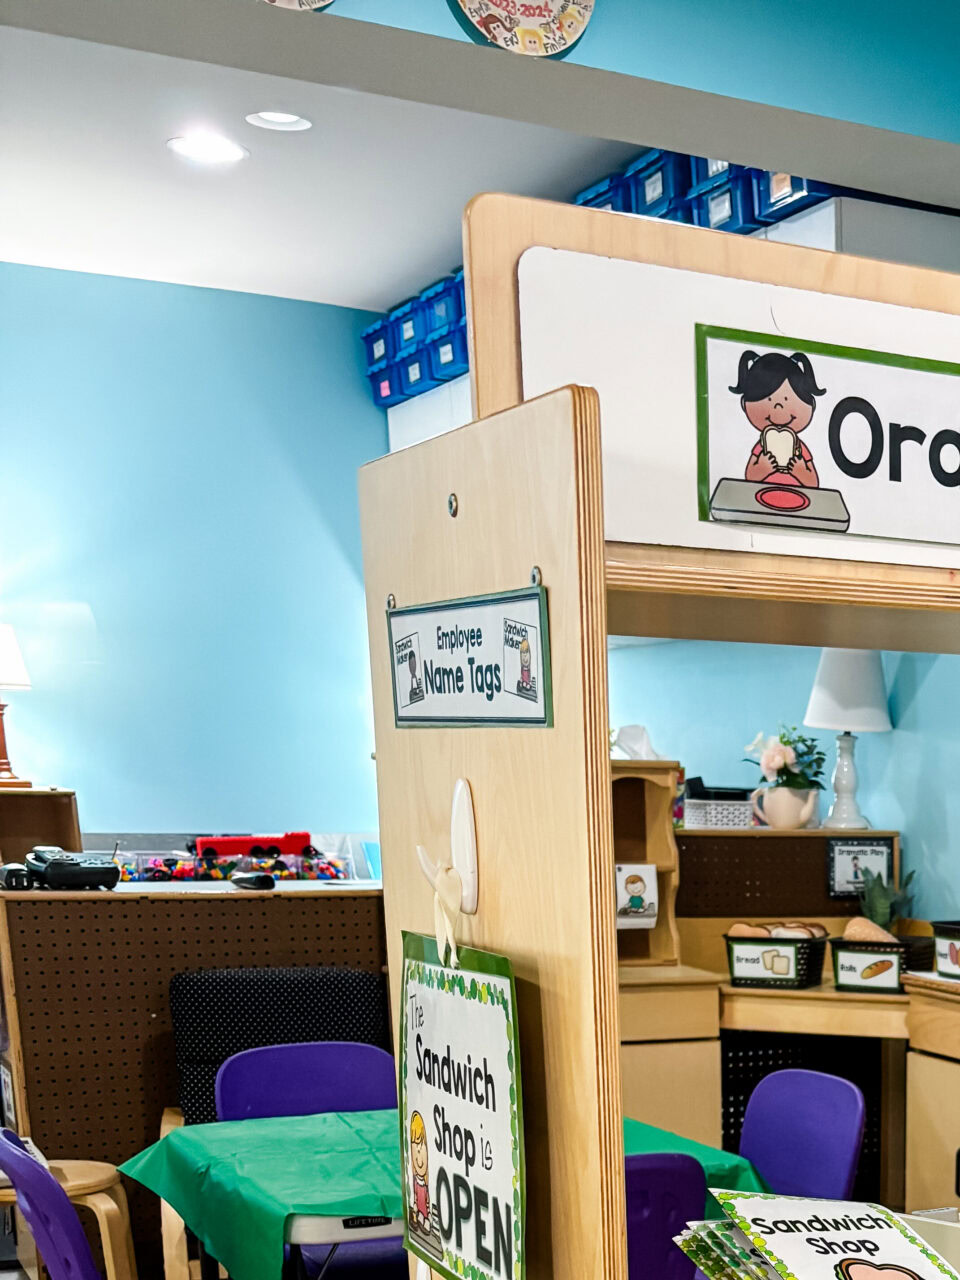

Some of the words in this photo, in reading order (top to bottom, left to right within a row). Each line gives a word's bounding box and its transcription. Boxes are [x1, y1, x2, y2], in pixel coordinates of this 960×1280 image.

[436, 624, 483, 655] Employee
[423, 659, 465, 695] Name
[467, 657, 502, 701] Tags
[735, 954, 760, 965] Bread
[409, 993, 424, 1030] The
[415, 1033, 497, 1112] Sandwich
[433, 1103, 477, 1178] Shop
[480, 1123, 493, 1172] is
[750, 1212, 895, 1236] Sandwich
[805, 1236, 880, 1257] Shop
